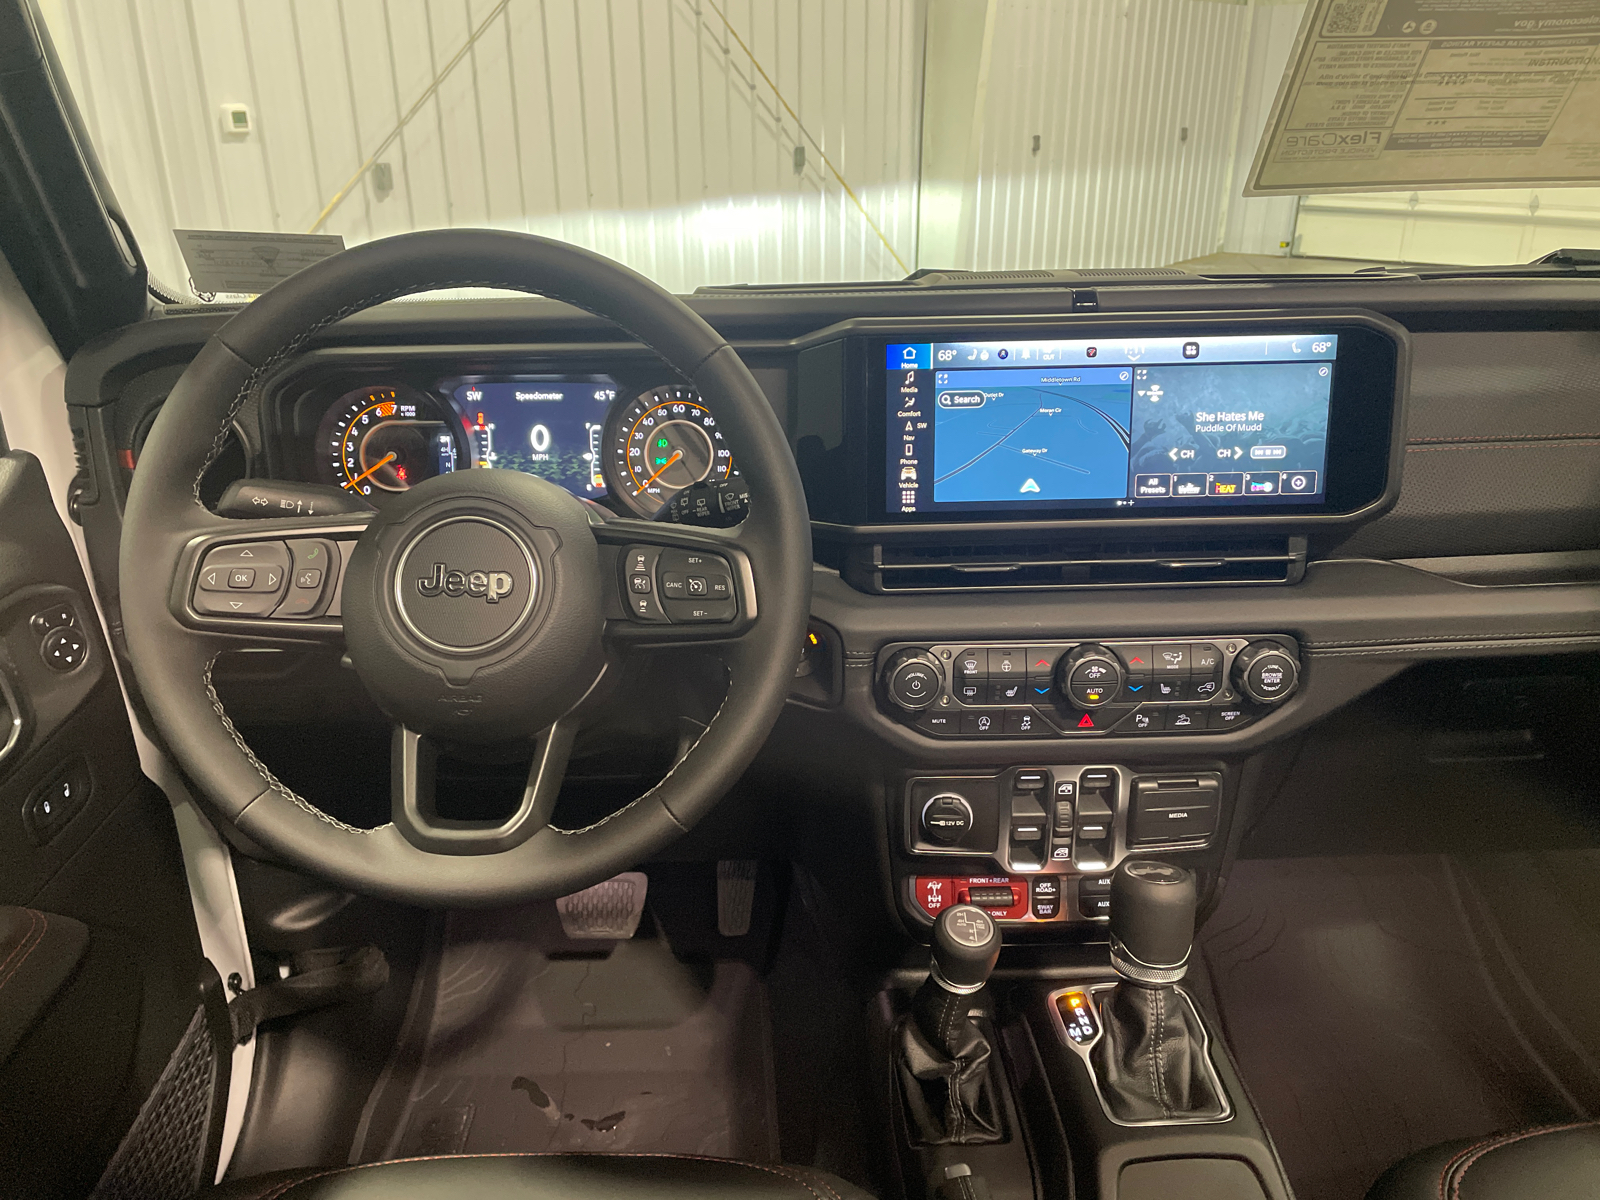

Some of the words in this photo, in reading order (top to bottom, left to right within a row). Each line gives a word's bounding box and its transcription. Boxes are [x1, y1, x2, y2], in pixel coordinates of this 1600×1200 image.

[467, 392, 482, 400] SW
[515, 392, 564, 401] Speedometer
[594, 390, 616, 400] 45°F
[954, 395, 980, 404] Search
[376, 408, 382, 416] 6
[391, 404, 398, 414] 7
[672, 404, 685, 413] 60
[362, 415, 369, 424] 5
[1196, 412, 1215, 422] She
[1217, 411, 1246, 421] Hates
[1248, 411, 1264, 421] Me
[643, 417, 654, 426] 40
[704, 417, 715, 426] 80
[351, 427, 358, 436] 4
[1195, 424, 1224, 432] Puddle
[1238, 423, 1262, 431] Mudd
[530, 424, 550, 452] 0
[346, 442, 354, 451] 3
[532, 453, 549, 461] MPH
[1180, 450, 1194, 458] CH
[1217, 449, 1231, 458] CH
[347, 458, 354, 467] 2
[363, 486, 371, 495] 0
[1215, 483, 1236, 494] HEAT
[235, 574, 248, 582] OK
[417, 563, 514, 604] Jeep
[1070, 999, 1080, 1007] P
[1078, 1016, 1089, 1025] N
[1069, 1027, 1082, 1036] M
[1082, 1026, 1093, 1035] D
